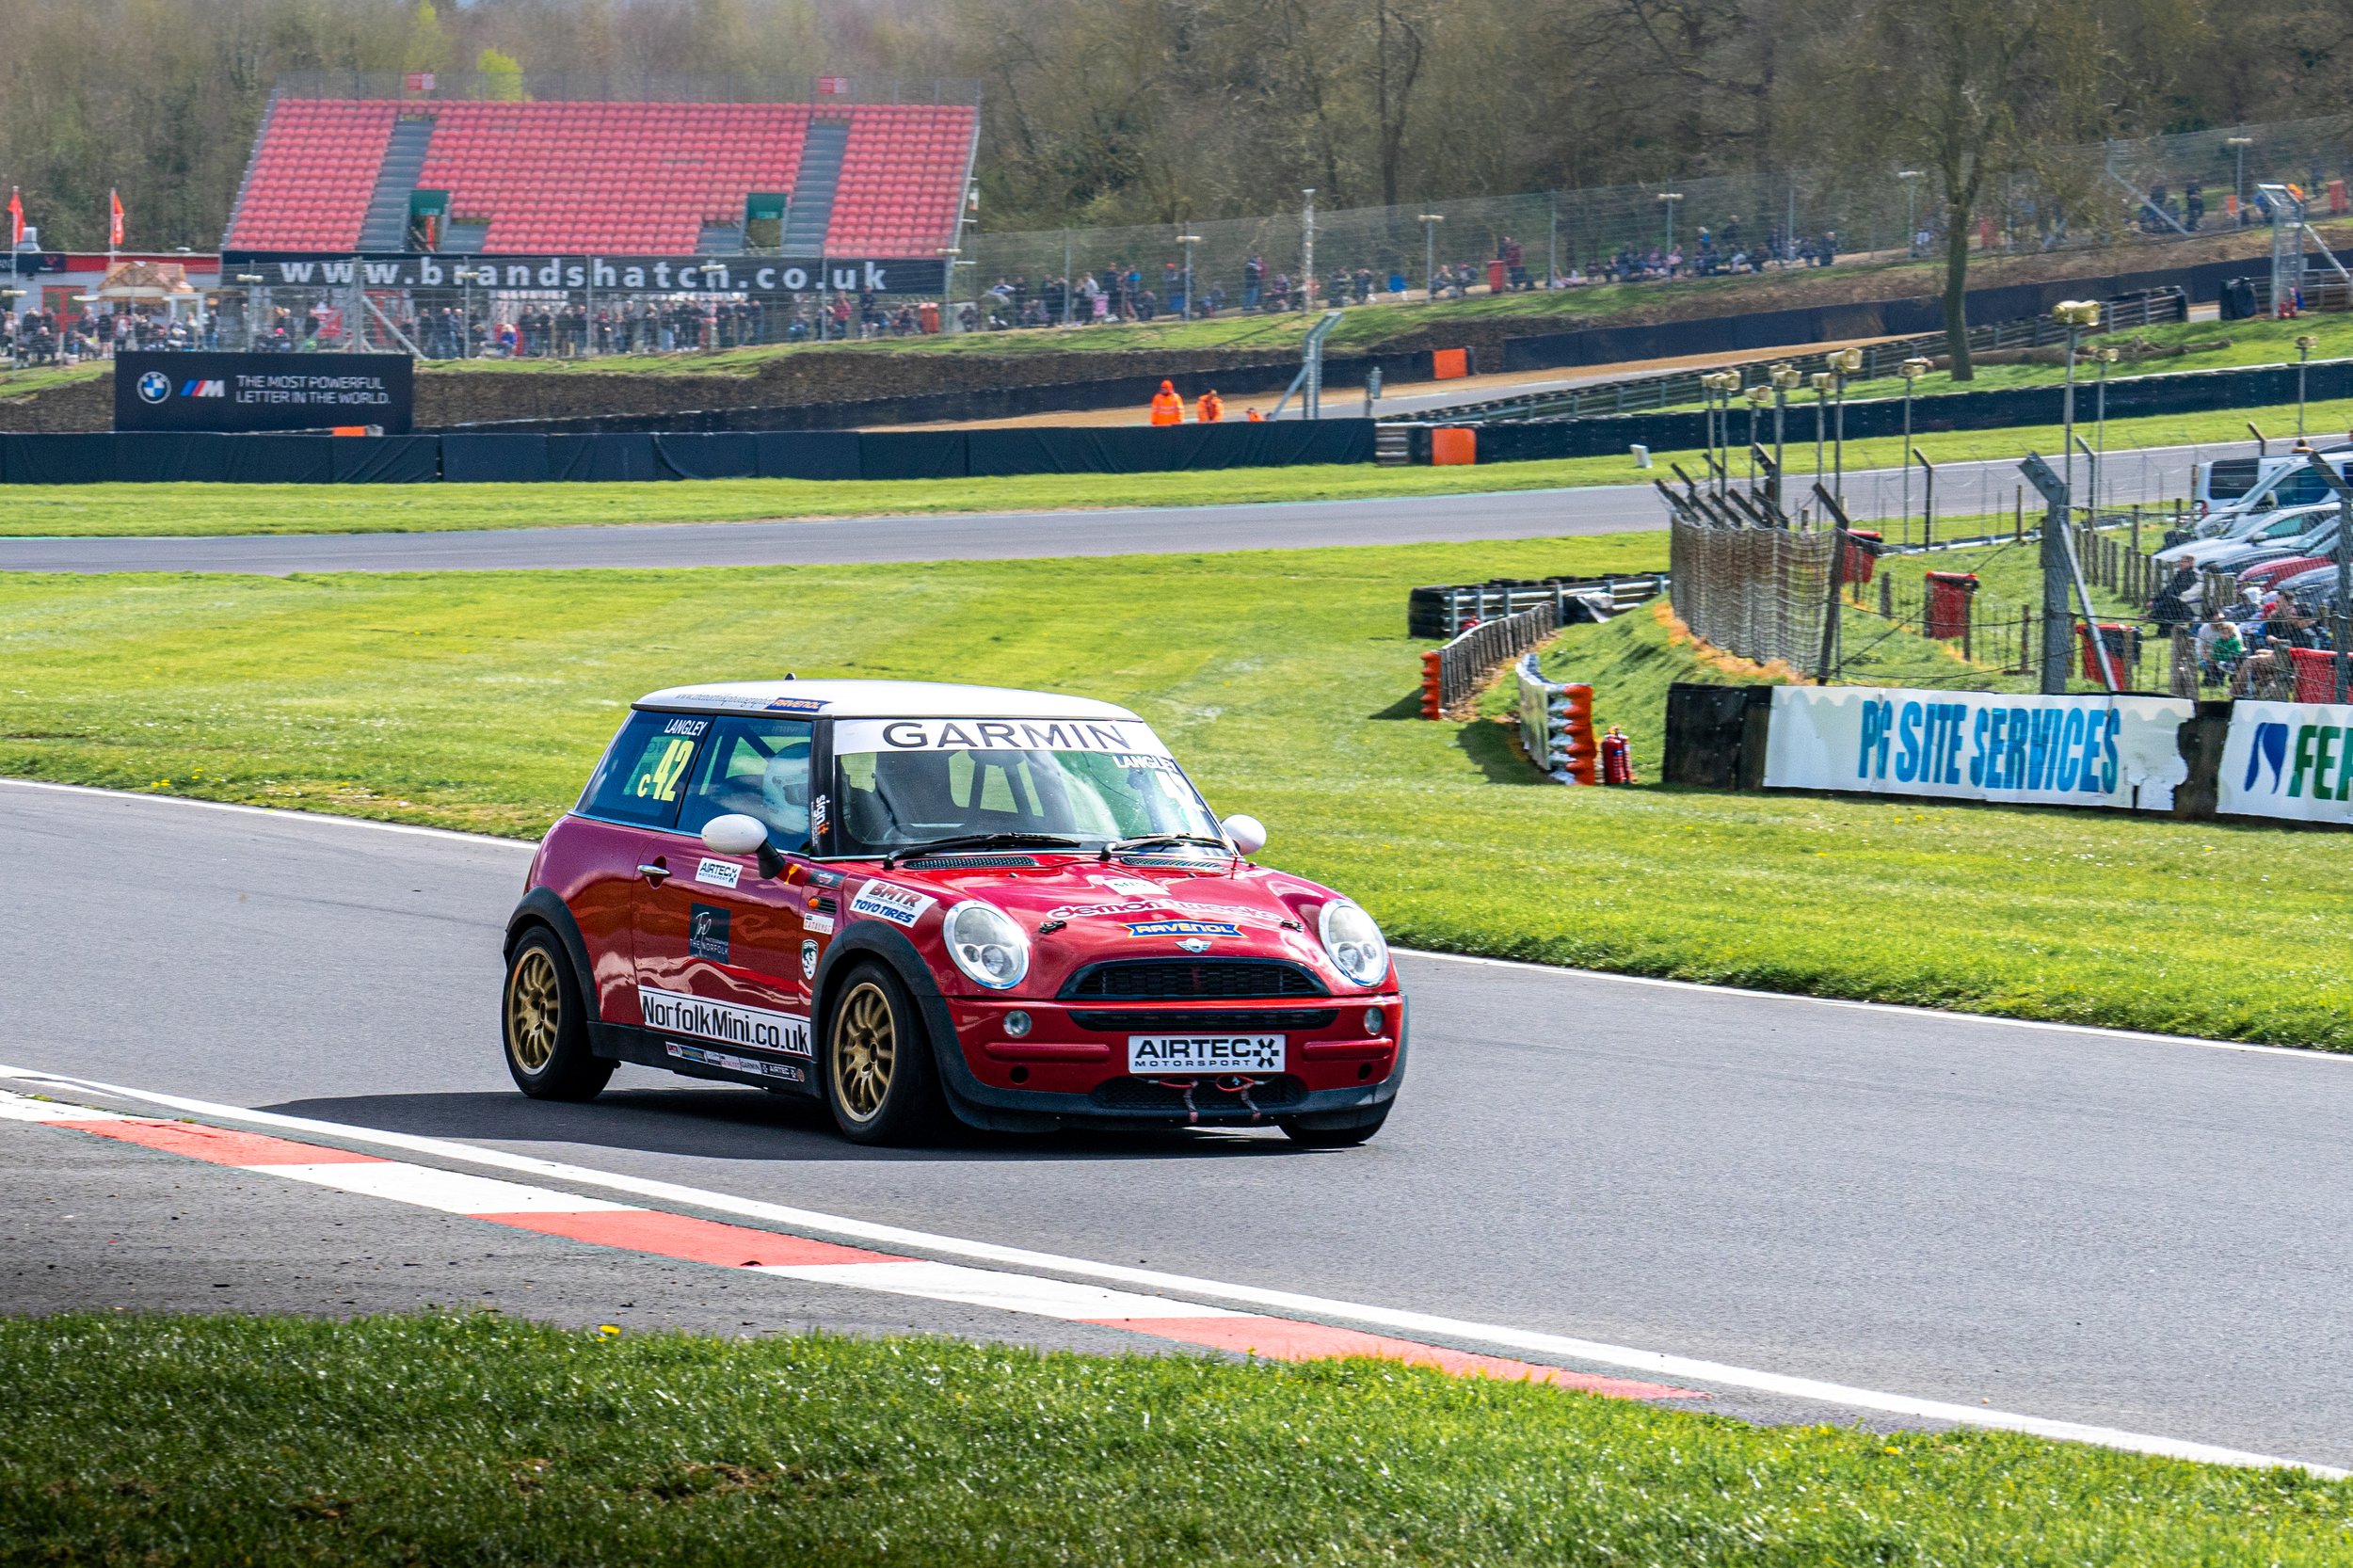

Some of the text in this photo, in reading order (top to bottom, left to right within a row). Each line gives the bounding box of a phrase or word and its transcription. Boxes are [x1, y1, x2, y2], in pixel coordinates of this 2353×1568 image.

[280, 256, 887, 290] www.brandshatch.co.uk
[236, 376, 384, 390] THE MOST POWERFUL
[235, 391, 392, 405] LETTER IN THE WORLD.
[664, 718, 708, 737] LANGLEY
[882, 721, 1132, 750] GARMIN
[1895, 700, 1967, 785] SITE
[1969, 707, 2121, 794] SERVICES
[699, 862, 731, 878] AIRTEC
[868, 882, 923, 907] BMTR
[854, 899, 916, 923] TOYO TIRES
[1136, 922, 1230, 935] RAVENOL
[642, 995, 809, 1055] NorfolkMini.co.uk
[1135, 1038, 1251, 1059] AIRTEC
